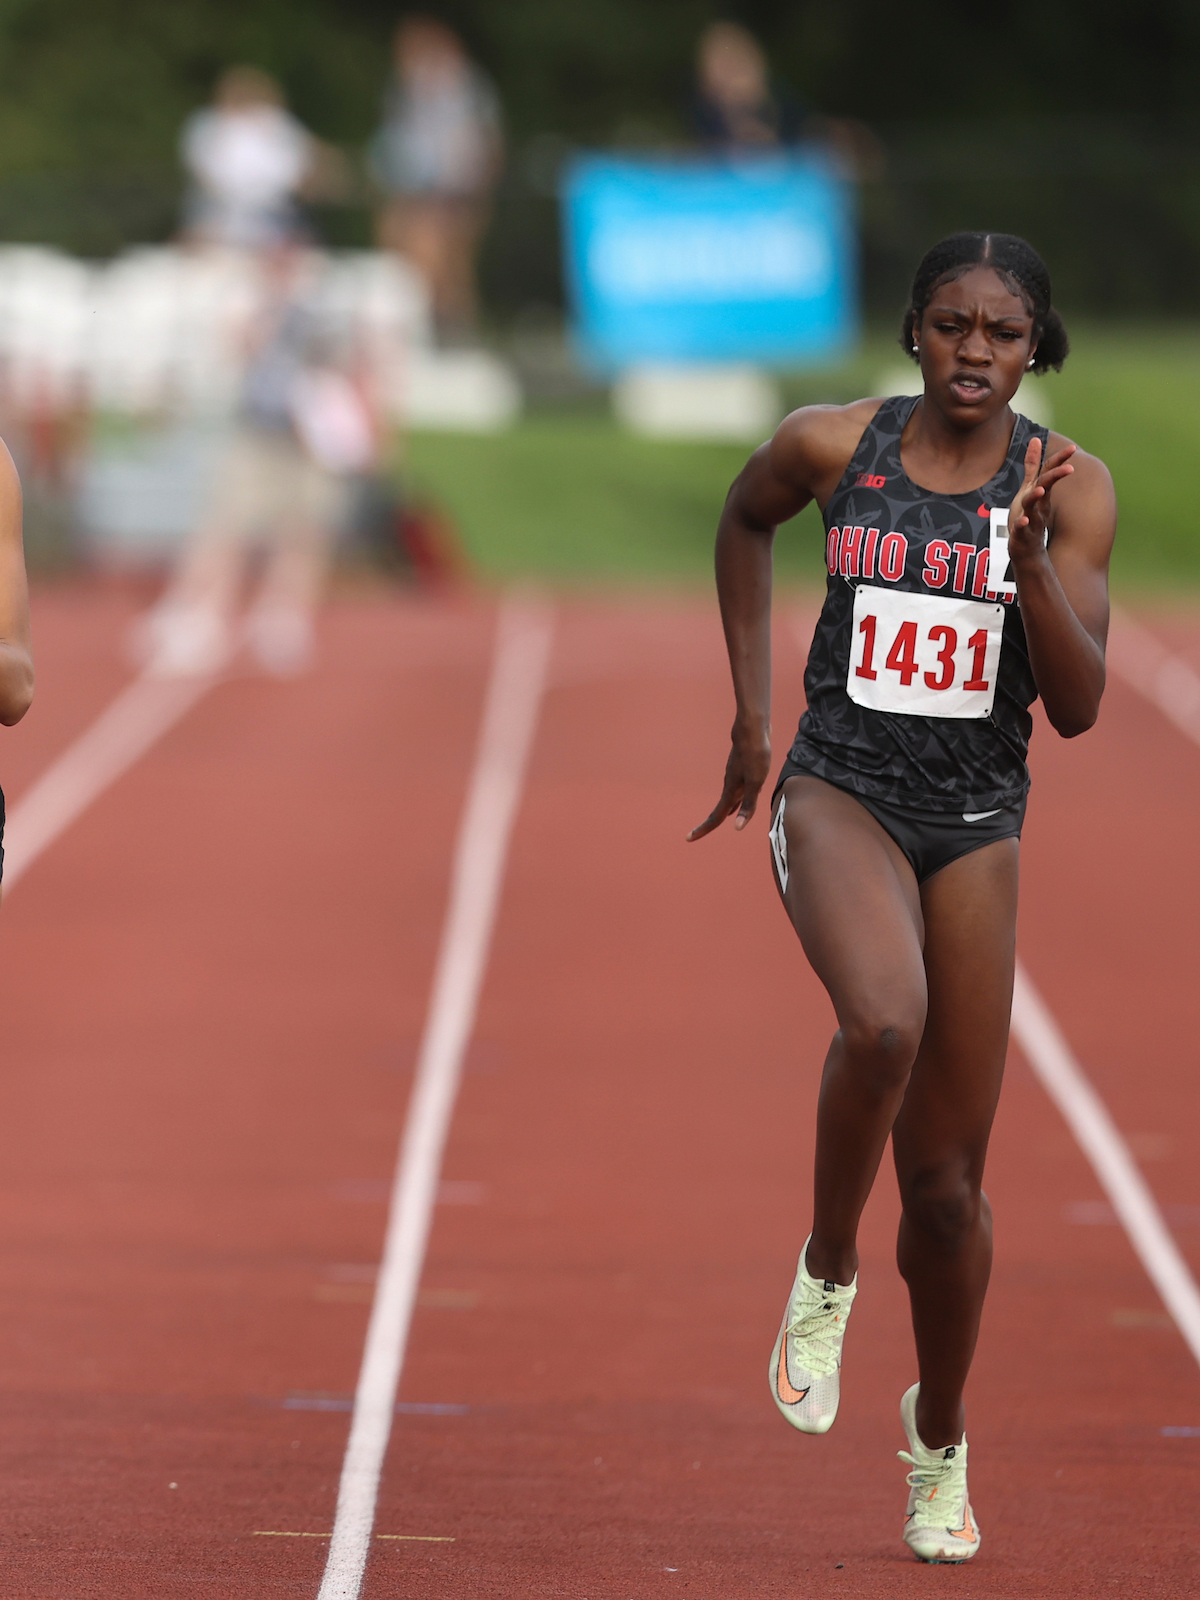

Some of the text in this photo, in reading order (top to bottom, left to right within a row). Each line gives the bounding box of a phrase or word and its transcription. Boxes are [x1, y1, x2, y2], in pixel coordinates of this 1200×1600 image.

[827, 525, 909, 583] OHIO
[922, 538, 1015, 605] STA
[855, 614, 989, 691] 1431
